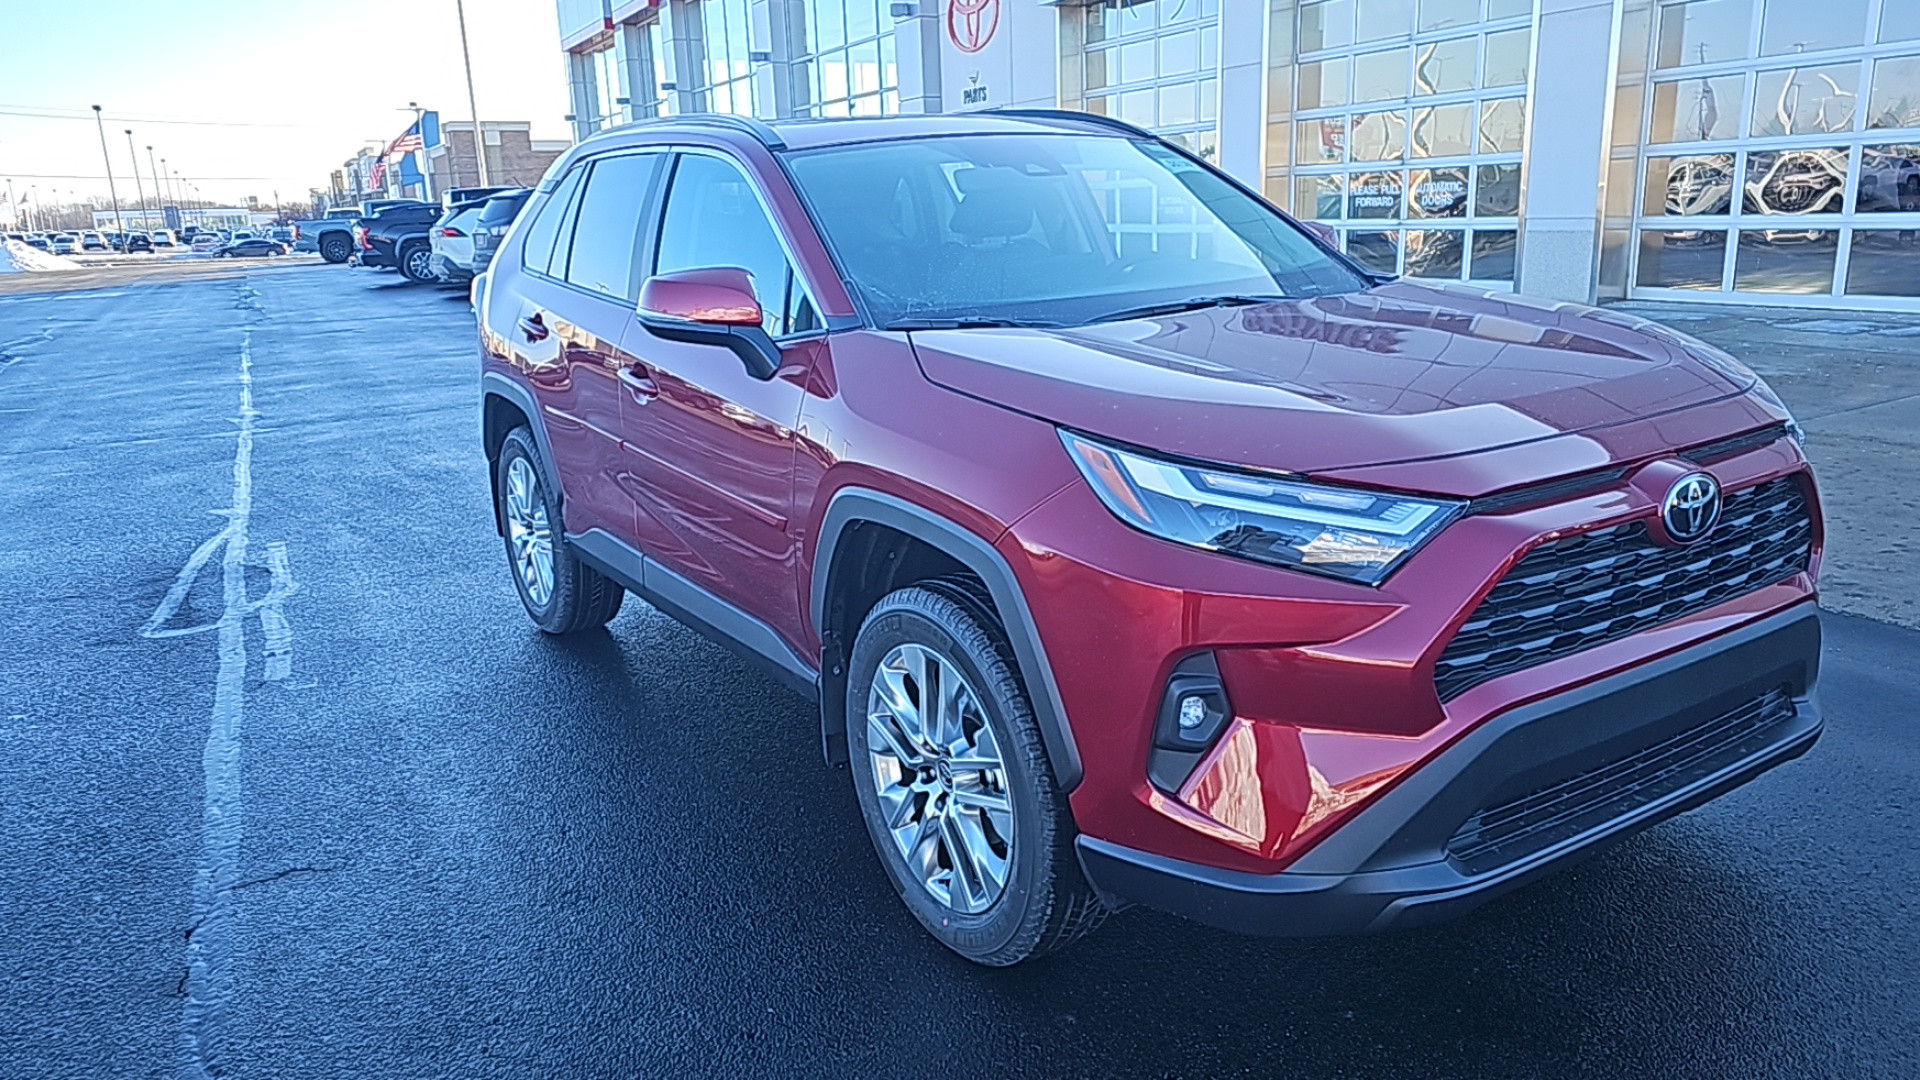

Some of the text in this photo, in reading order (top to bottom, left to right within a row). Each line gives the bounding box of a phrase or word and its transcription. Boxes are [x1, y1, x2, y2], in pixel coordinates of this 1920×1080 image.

[963, 86, 987, 104] PARTS
[1350, 184, 1400, 196] PLEASE PULL
[1417, 181, 1463, 194] AUTOMATIC
[1355, 197, 1393, 207] FORWARD
[1421, 196, 1454, 205] DOORS
